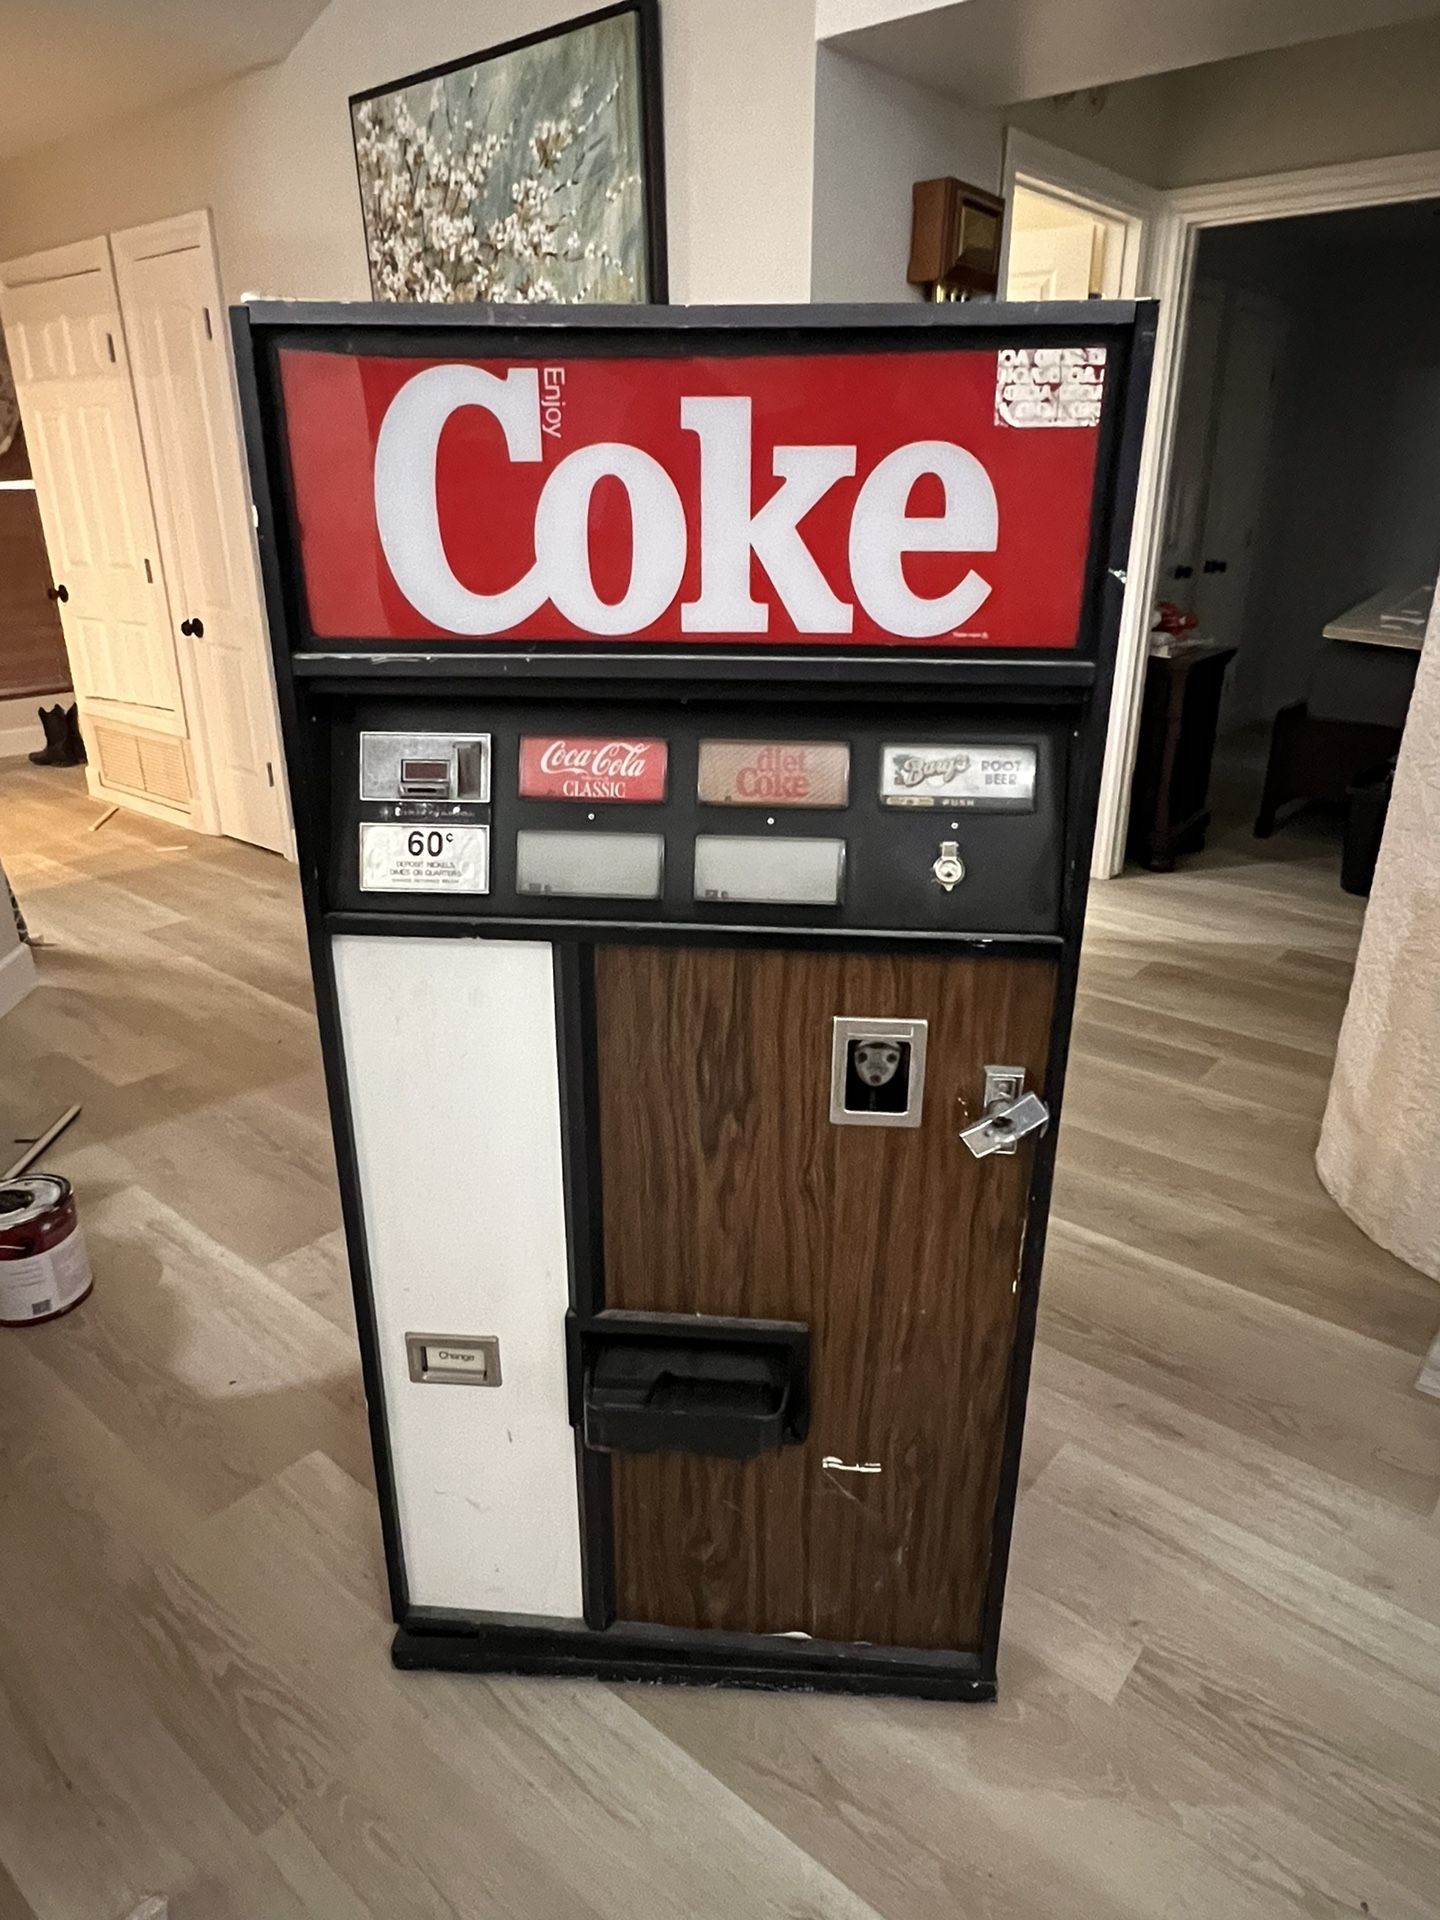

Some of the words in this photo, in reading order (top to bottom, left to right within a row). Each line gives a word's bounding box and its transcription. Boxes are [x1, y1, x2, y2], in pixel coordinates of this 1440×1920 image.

[541, 367, 566, 438] Enjoy
[374, 364, 999, 638] Coke
[540, 740, 651, 777] Coca-Cola
[757, 746, 806, 773] diet
[981, 760, 1021, 772] ROOT
[563, 780, 626, 798] CLASSIC
[736, 767, 811, 799] Coke
[985, 774, 1017, 785] BEER
[438, 1351, 475, 1361] Change
